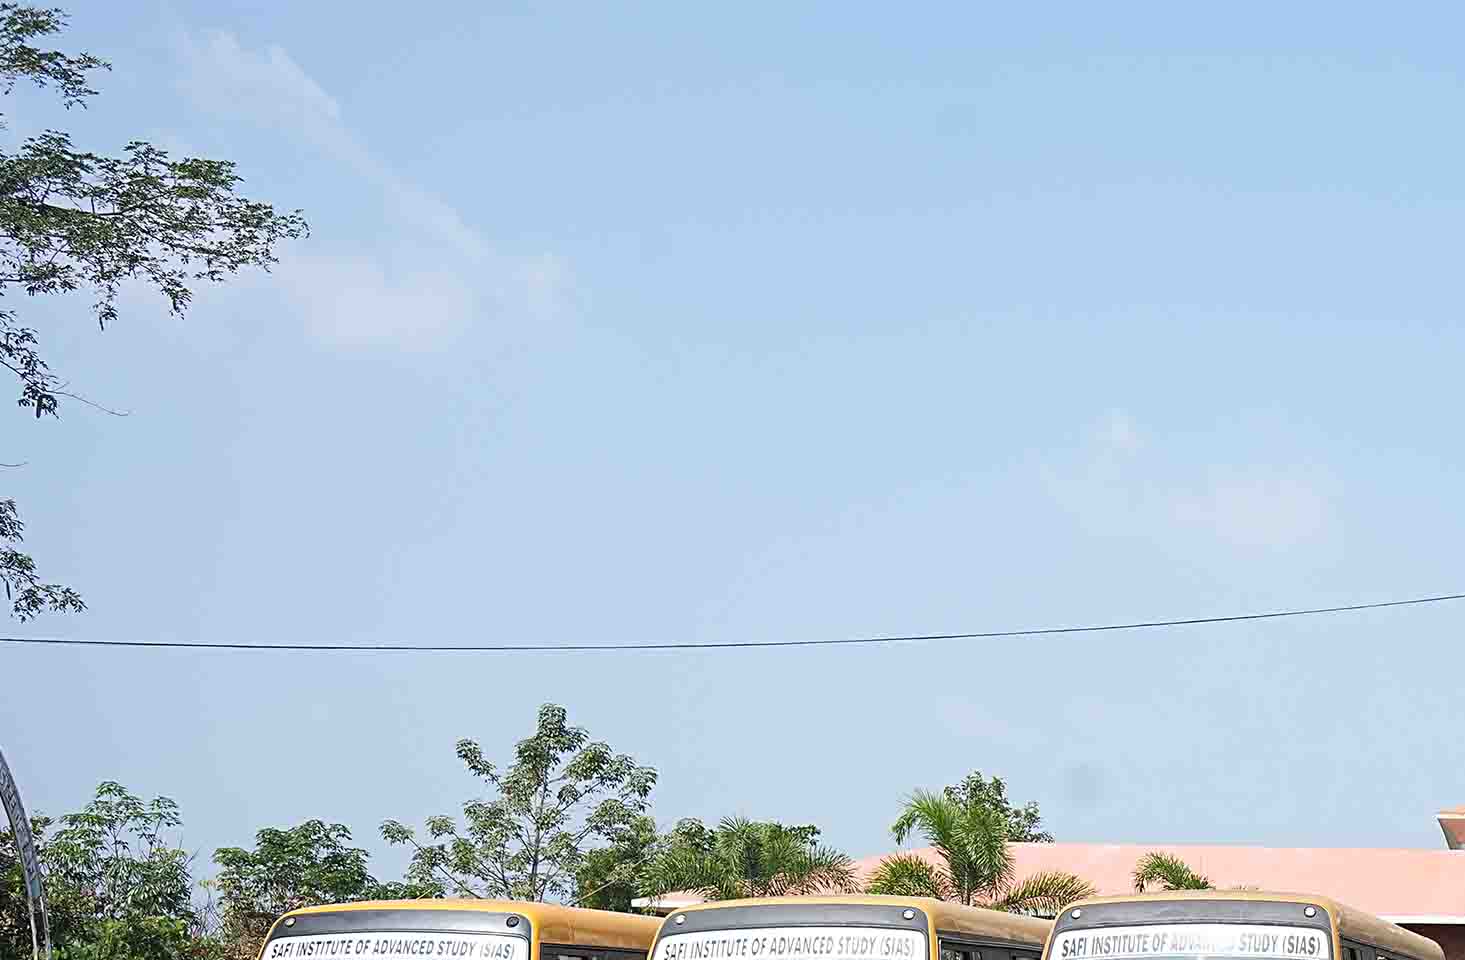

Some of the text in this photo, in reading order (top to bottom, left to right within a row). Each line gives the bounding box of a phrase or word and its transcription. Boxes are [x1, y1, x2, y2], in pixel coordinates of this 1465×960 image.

[271, 939, 515, 960] SAFI INSTITUTE OF ADVANCED STUDY (SIAS)
[690, 938, 749, 959] INSTITUTE
[752, 937, 767, 956] OF
[769, 937, 834, 955] ADVANCED
[837, 936, 877, 955] STUDY
[880, 936, 914, 958] (SIAS)
[1062, 937, 1088, 957] SAFI
[1091, 934, 1149, 955] INSTITUTE
[1152, 932, 1168, 952] OF
[1239, 932, 1279, 952] STUDY
[1282, 935, 1321, 956] (SIAS)
